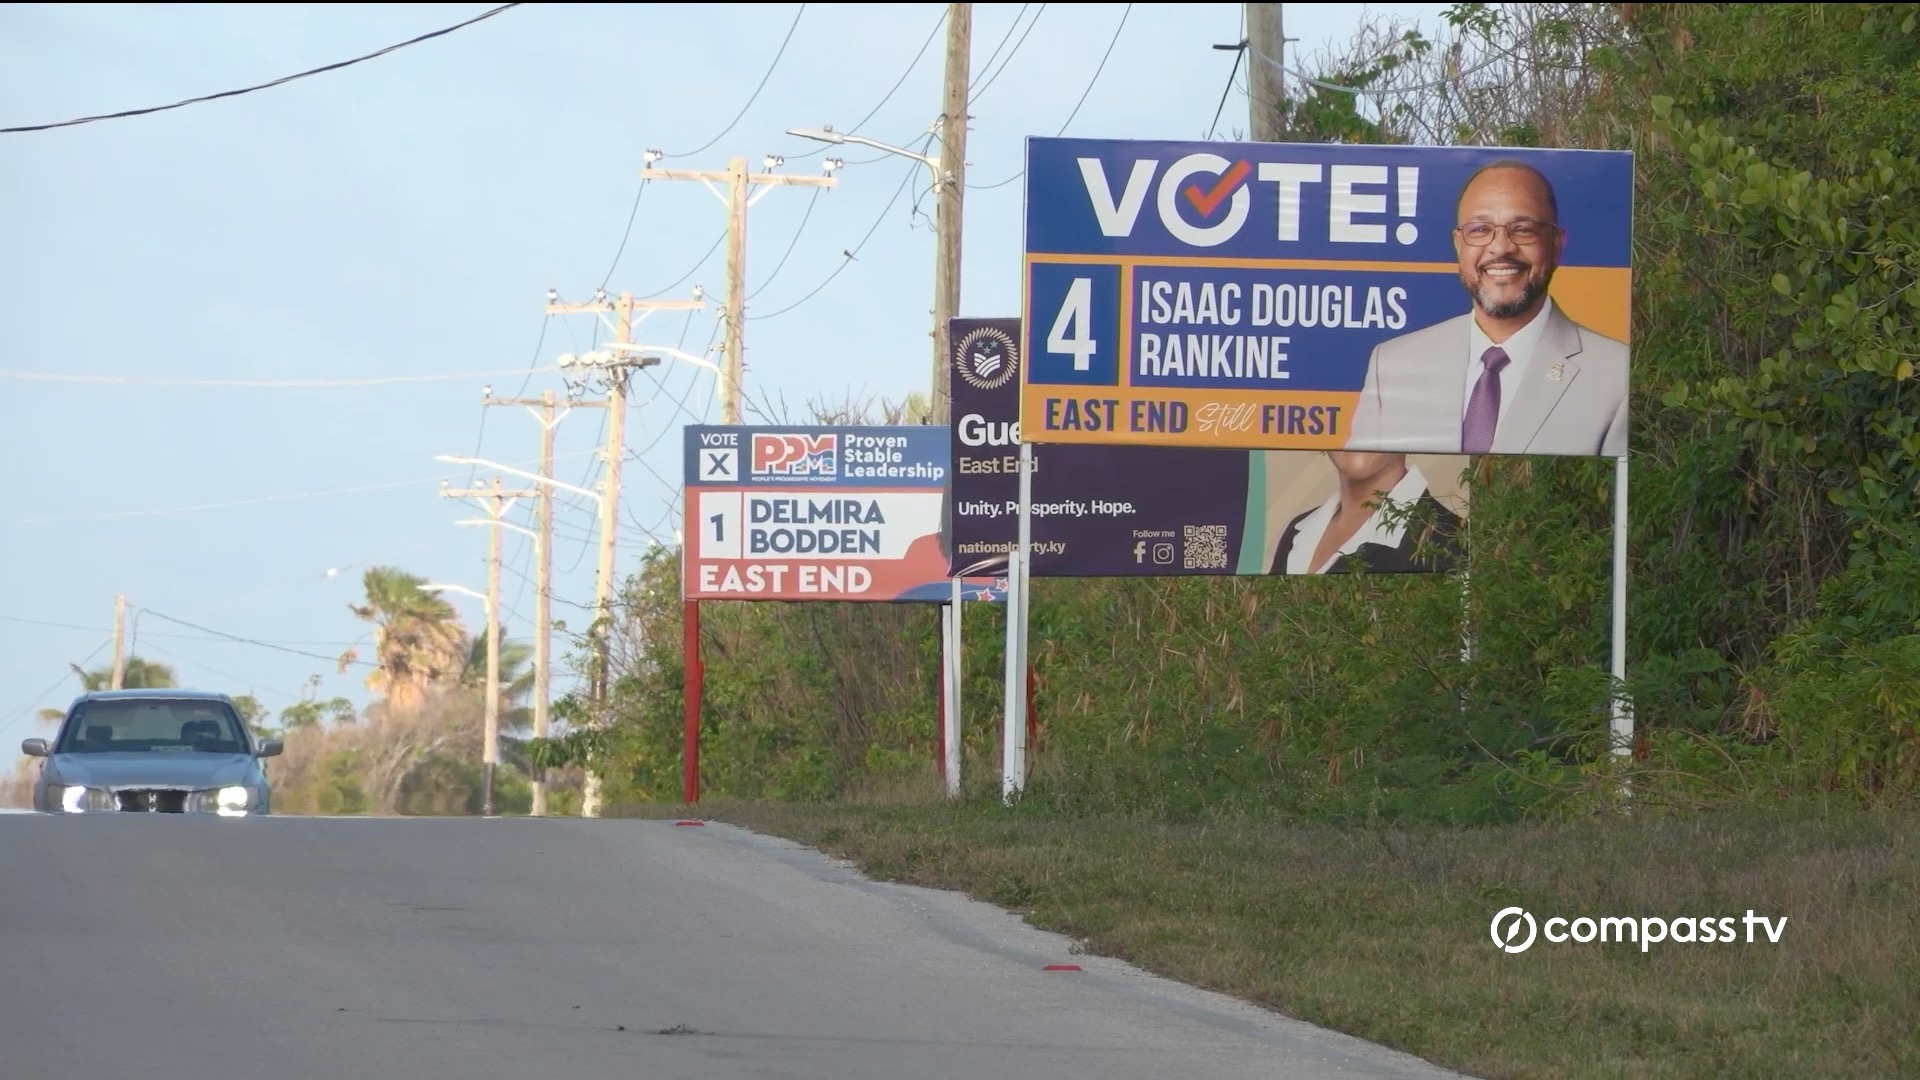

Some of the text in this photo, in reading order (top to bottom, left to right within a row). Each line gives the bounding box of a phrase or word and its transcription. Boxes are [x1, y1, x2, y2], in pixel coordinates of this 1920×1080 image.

[1076, 153, 1419, 247] VOTE!
[1140, 280, 1408, 330] ISAAC DOUGLAS
[1046, 277, 1097, 371] 4
[1139, 333, 1291, 379] RANKINE
[1045, 398, 1341, 437] EAST END Still FIRST
[700, 433, 738, 446] VOTE
[844, 434, 907, 448] Proven
[752, 433, 837, 475] PPM
[844, 448, 902, 463] Stable
[959, 456, 1001, 474] East
[844, 463, 944, 481] Leadership
[750, 499, 885, 524] DELMIRA
[958, 500, 1136, 518] Unity. Prsperity. Hope.
[710, 513, 724, 542] 1
[1132, 529, 1176, 538] Follow me
[750, 528, 880, 554] BODDEN
[958, 541, 1066, 555] nationalrty.ky
[700, 564, 872, 593] EAST END
